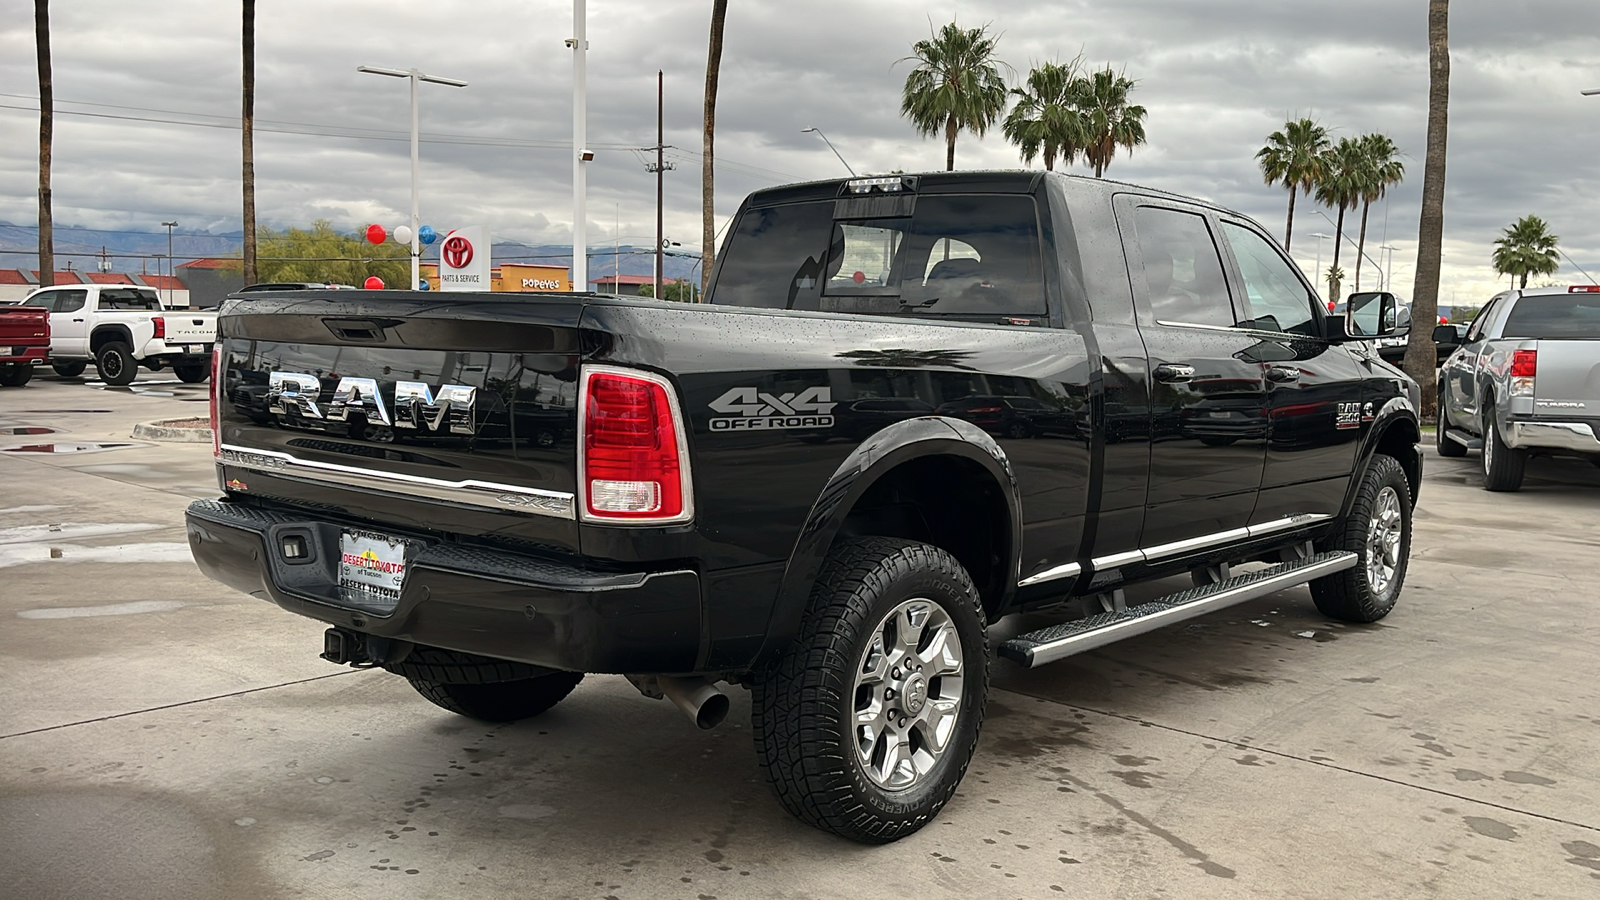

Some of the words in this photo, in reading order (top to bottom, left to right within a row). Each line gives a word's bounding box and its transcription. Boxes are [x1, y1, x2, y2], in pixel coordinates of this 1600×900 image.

[442, 275, 455, 283] PARTS
[460, 275, 480, 283] SERVICE
[268, 370, 478, 435] RAM
[711, 418, 766, 430] OFF
[768, 416, 833, 428] ROAD
[357, 530, 389, 542] TUCSON
[342, 553, 369, 568] DESERT
[371, 559, 404, 574] TOYOTA
[364, 570, 382, 578] Tucson
[340, 577, 366, 591] DESERT
[368, 585, 399, 599] TOYOTA
